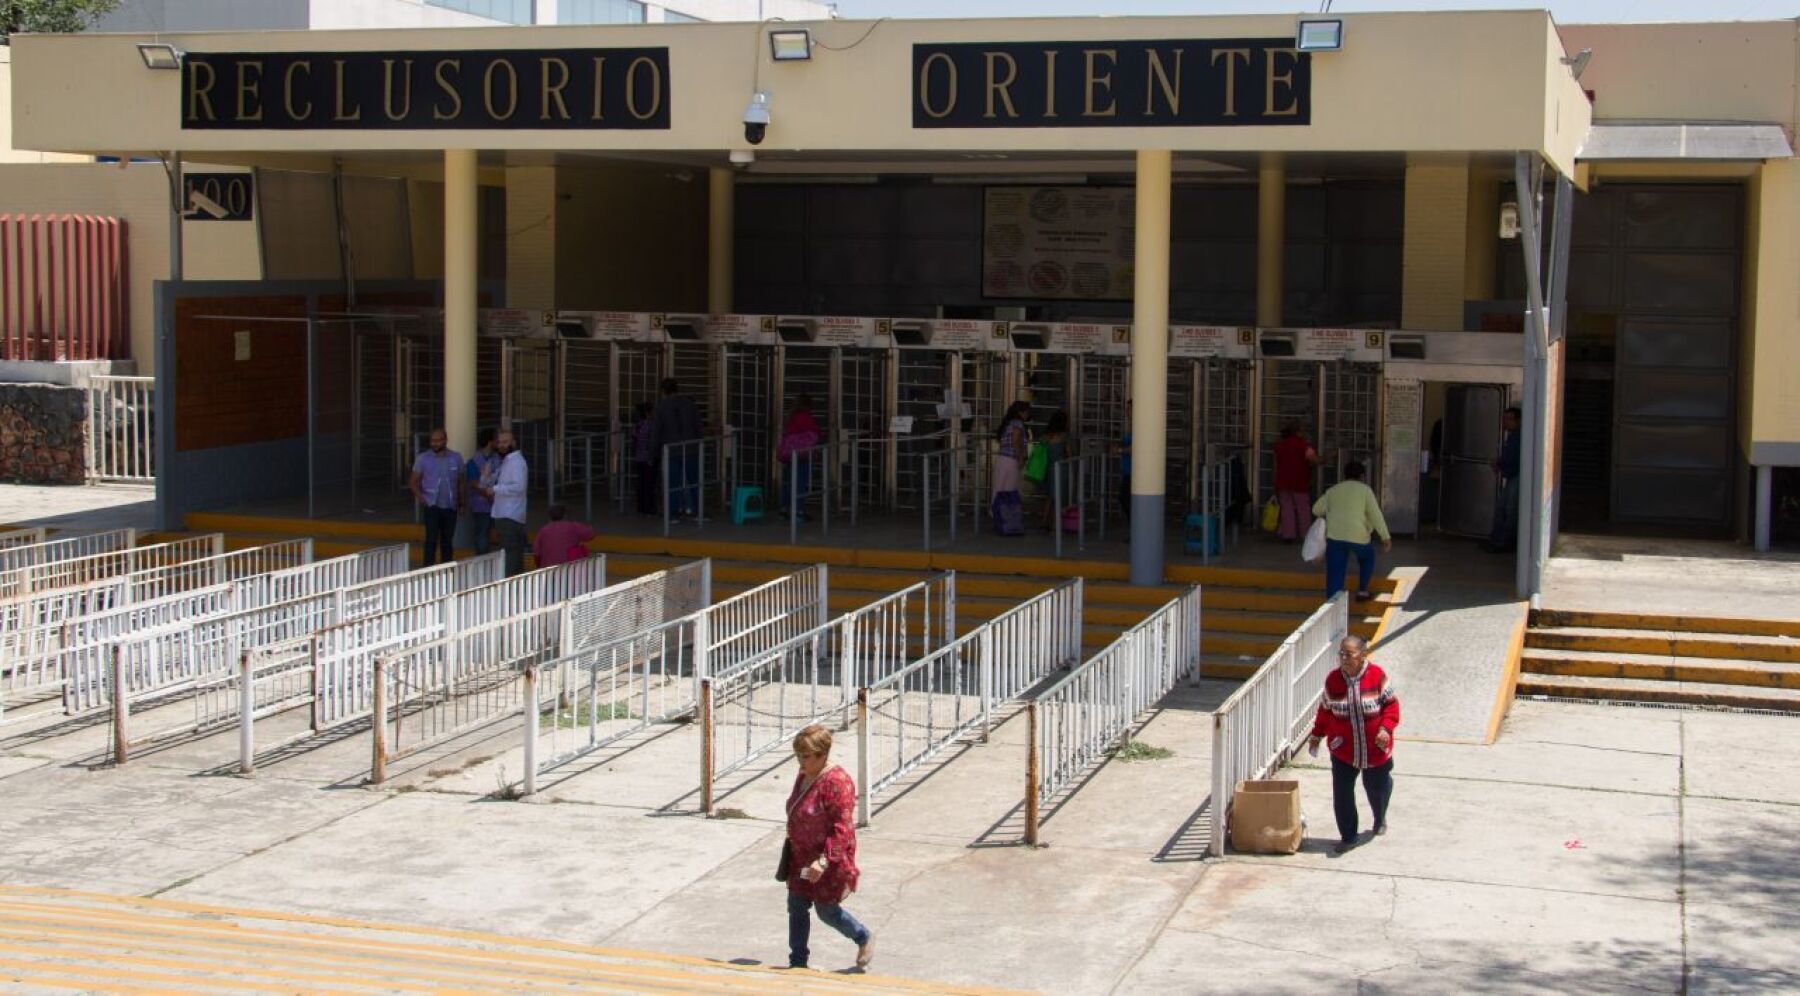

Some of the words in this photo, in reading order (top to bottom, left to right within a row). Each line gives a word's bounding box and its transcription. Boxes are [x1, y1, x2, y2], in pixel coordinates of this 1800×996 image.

[187, 55, 662, 121] RECLUSORIO
[919, 46, 1300, 118] ORIENTE
[653, 316, 663, 328] 3
[763, 318, 773, 329] 4
[879, 321, 889, 333] 5
[995, 324, 1005, 336] 6
[1116, 328, 1126, 340] 7
[1241, 330, 1252, 342] 8
[1369, 334, 1379, 346] 9
